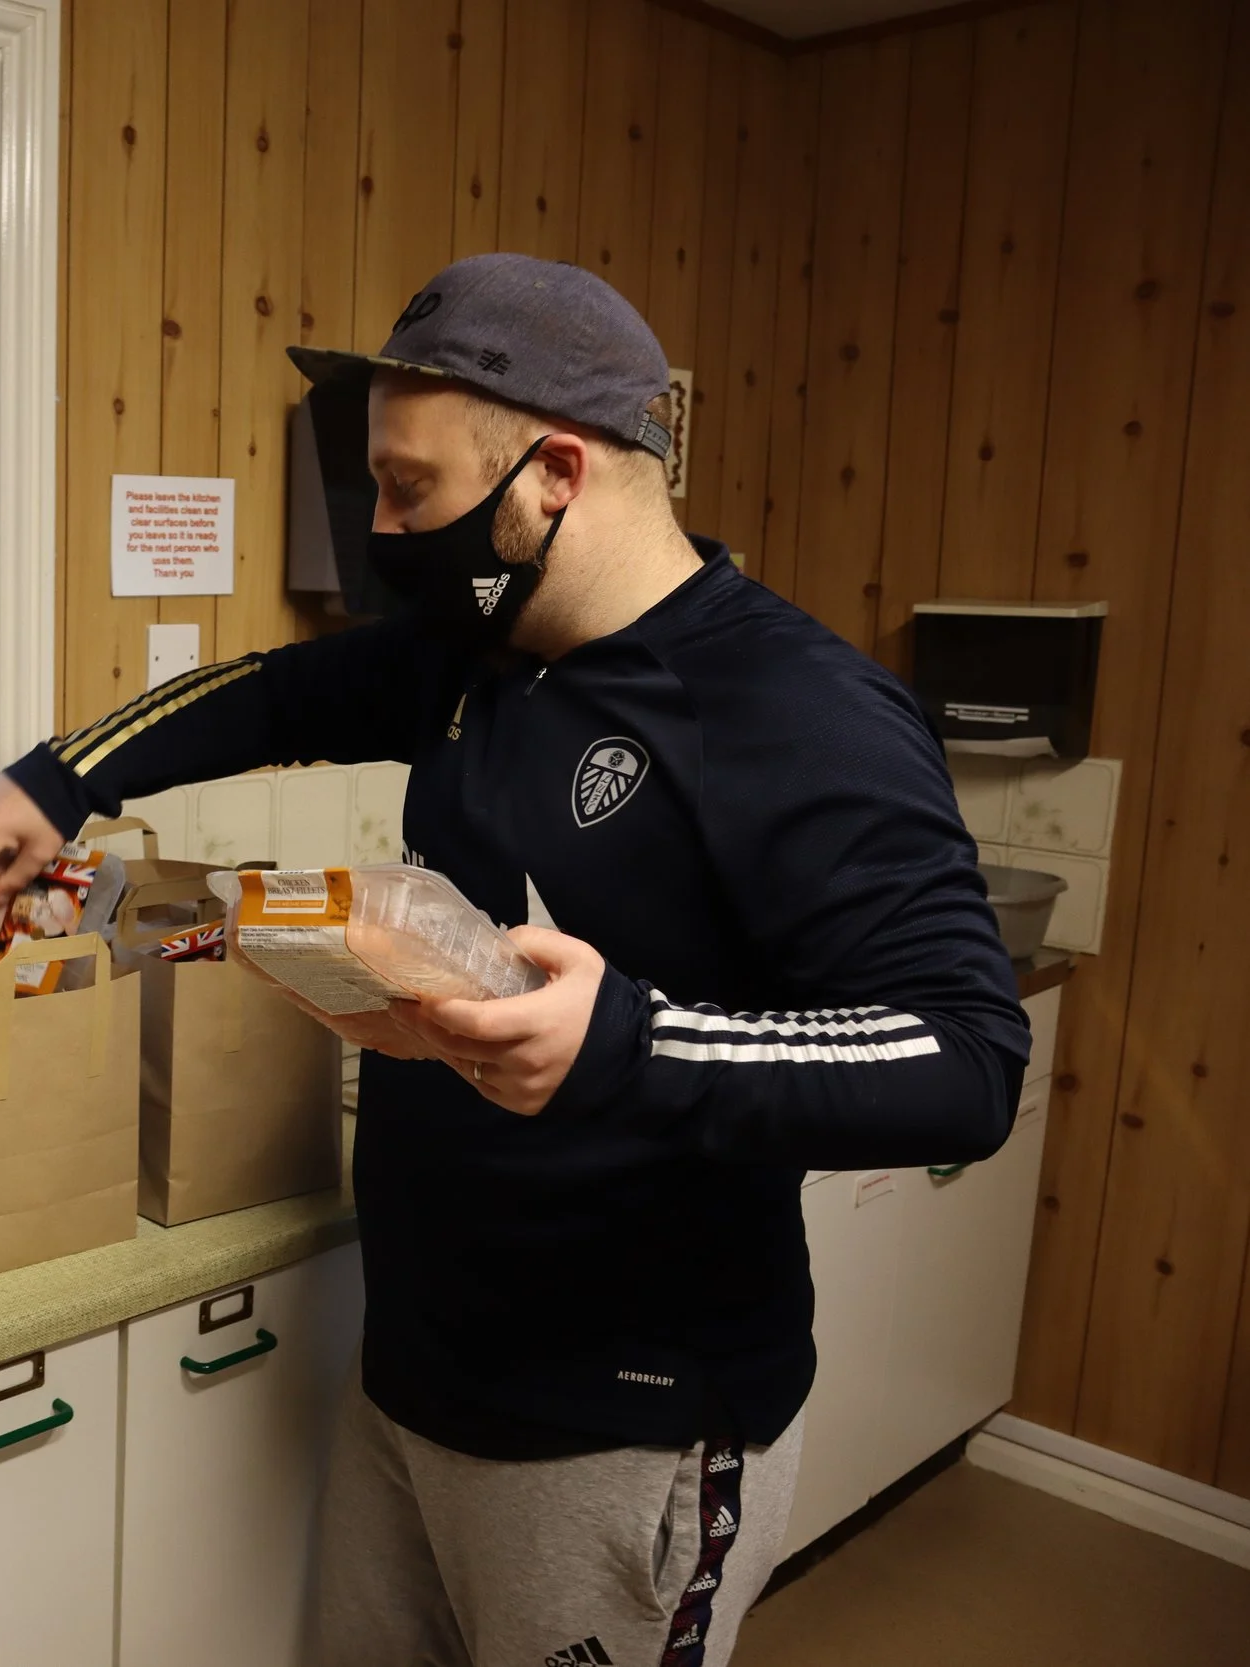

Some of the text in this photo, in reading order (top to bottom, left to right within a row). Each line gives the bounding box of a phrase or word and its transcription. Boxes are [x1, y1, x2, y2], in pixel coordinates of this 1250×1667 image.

[126, 491, 221, 503] Please leave the kitchen
[128, 505, 218, 515] and facilities clean and
[131, 518, 215, 528] clear surfaces before
[128, 531, 218, 542] you leave so it is ready
[126, 543, 219, 554] for the next person who
[152, 556, 194, 565] uses them.
[154, 568, 194, 579] Thank you
[482, 573, 510, 616] adidas
[277, 879, 311, 887] CHICKEN
[267, 887, 326, 895] BREAST FILLETS
[617, 1370, 675, 1387] AEROREADY
[708, 1458, 739, 1473] adidas
[709, 1523, 737, 1537] adidas
